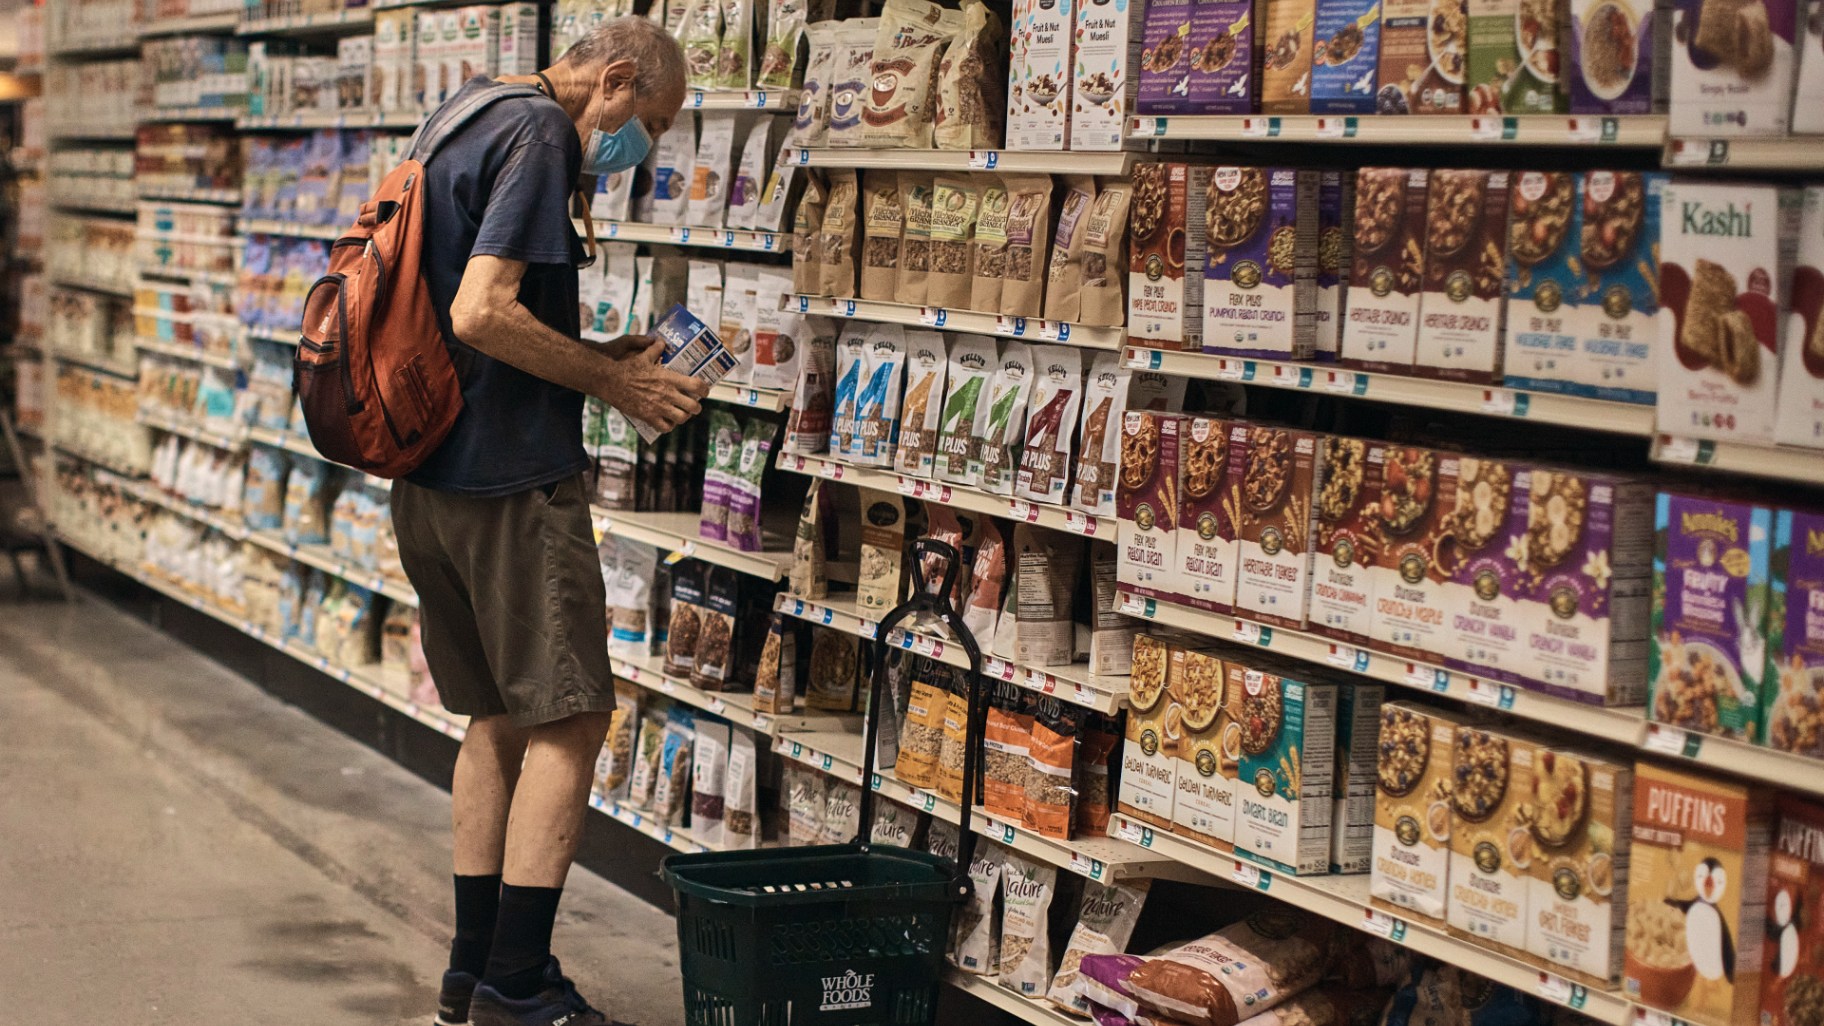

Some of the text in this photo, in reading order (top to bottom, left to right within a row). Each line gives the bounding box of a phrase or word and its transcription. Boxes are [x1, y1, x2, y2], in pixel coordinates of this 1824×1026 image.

[1032, 22, 1060, 33] Fruit & Nut
[1085, 19, 1116, 30] Fruit & Nut
[1036, 34, 1054, 44] Muesli
[1089, 31, 1110, 41] Muesli
[1681, 202, 1753, 239] Kashi
[859, 420, 880, 437] PLUS
[902, 430, 921, 448] PLUS
[944, 436, 968, 455] PLUS
[982, 444, 1001, 464] PLUS
[1028, 451, 1051, 472] PLUS
[1080, 463, 1099, 483] PLUS
[1647, 786, 1727, 837] PUFFINS
[821, 973, 875, 991] WHOLE
[822, 988, 871, 1005] FOODS
